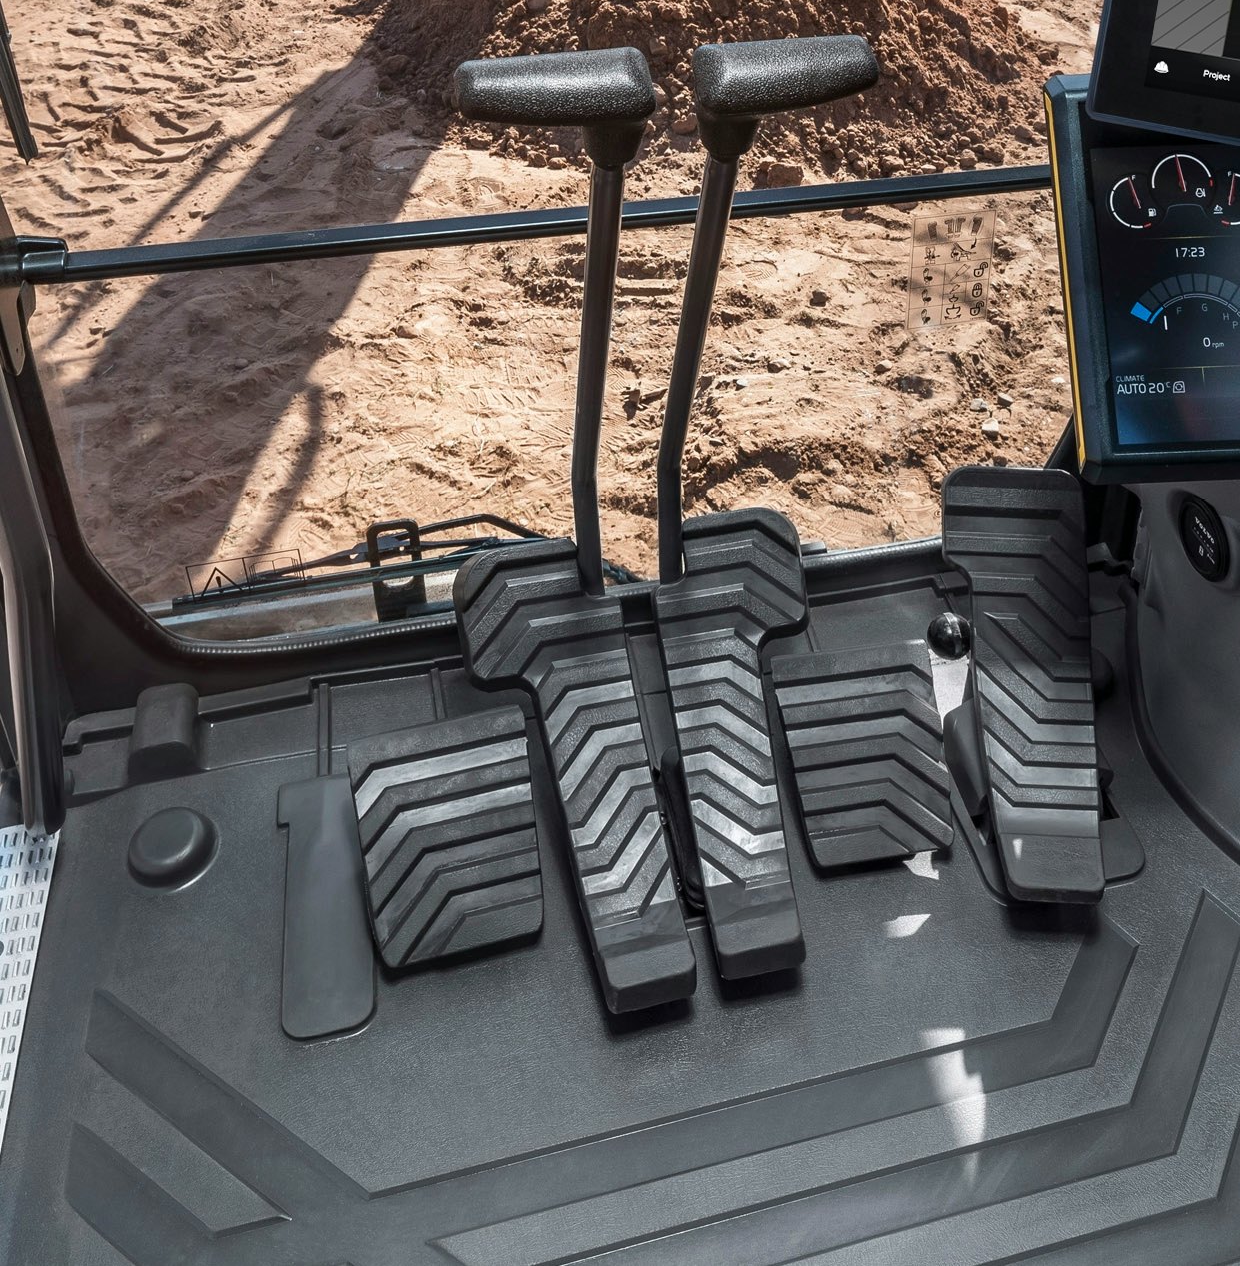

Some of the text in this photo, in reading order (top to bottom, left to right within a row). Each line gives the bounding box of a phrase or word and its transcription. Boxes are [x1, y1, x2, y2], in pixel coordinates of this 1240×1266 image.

[1203, 69, 1231, 81] Project
[1175, 247, 1205, 258] 17:23
[1176, 307, 1182, 315] F
[1202, 303, 1207, 312] G
[1223, 313, 1230, 321] H
[1232, 321, 1239, 329] P
[1203, 337, 1211, 347] 0
[1116, 383, 1147, 394] AUTO
